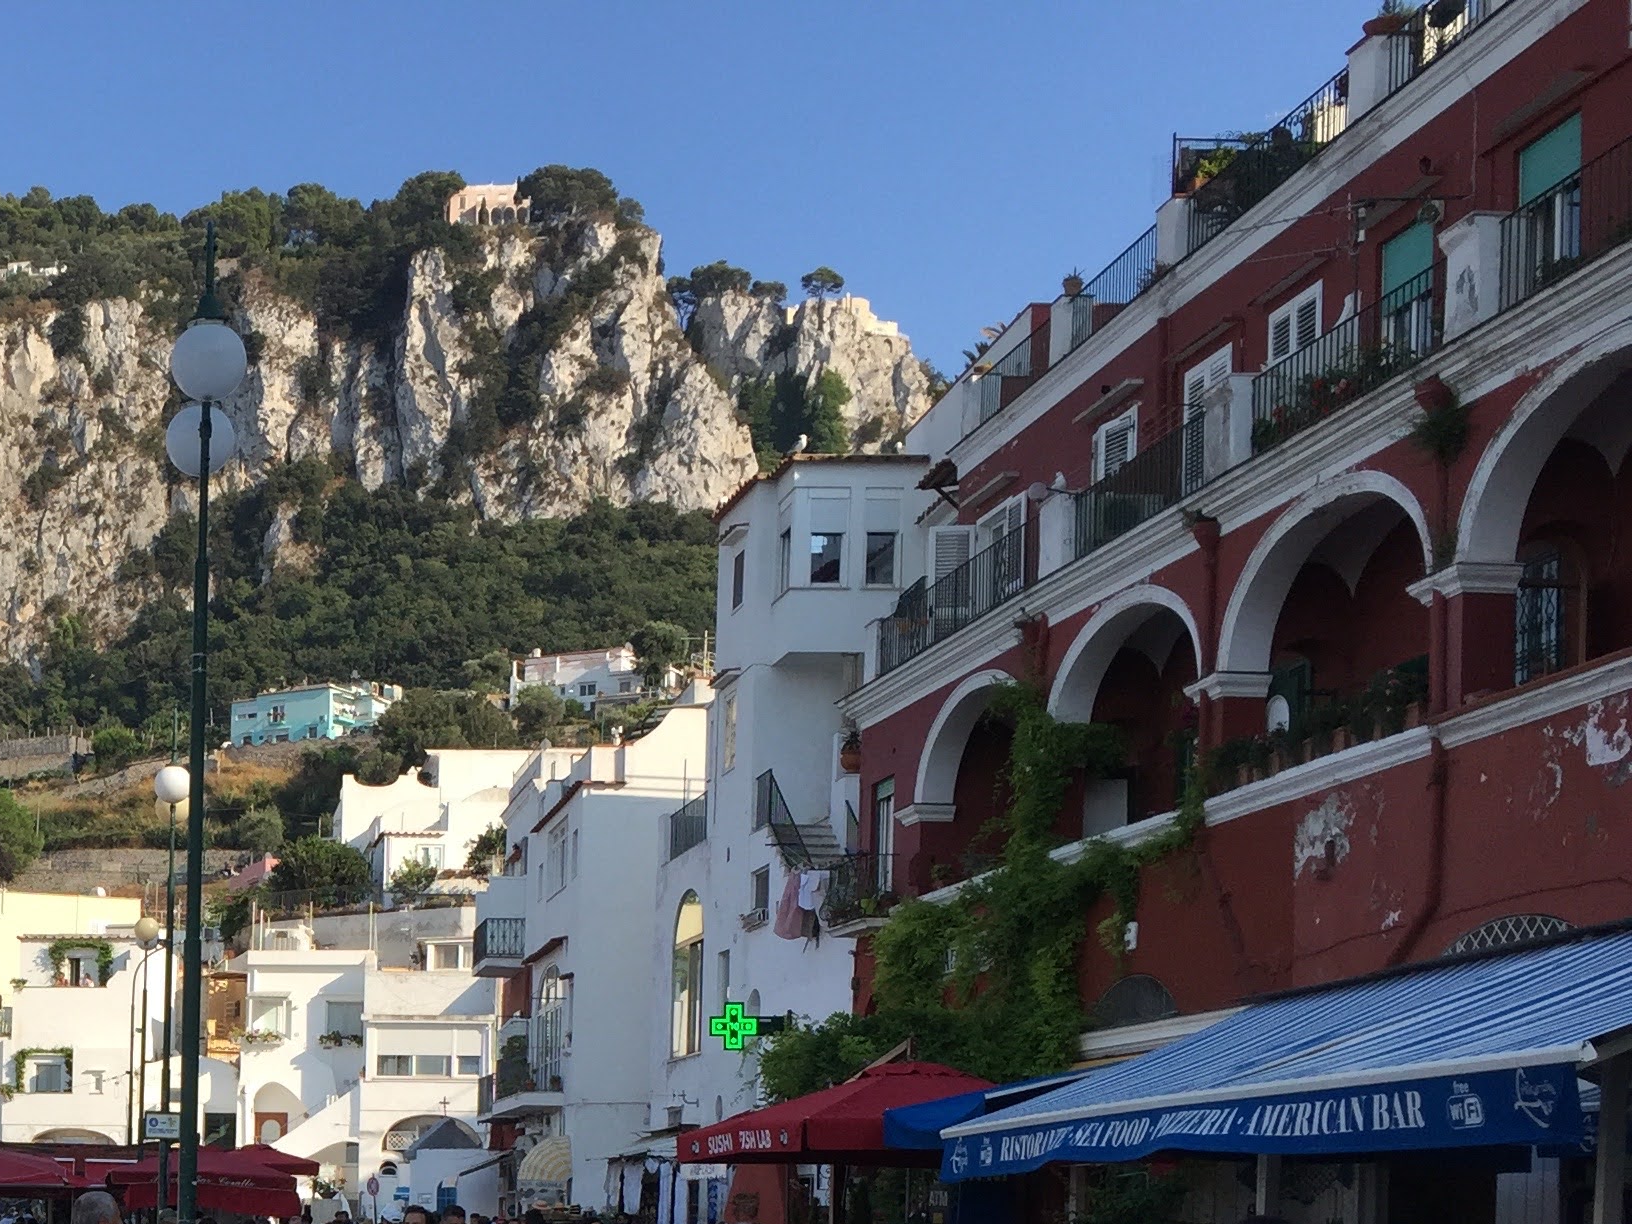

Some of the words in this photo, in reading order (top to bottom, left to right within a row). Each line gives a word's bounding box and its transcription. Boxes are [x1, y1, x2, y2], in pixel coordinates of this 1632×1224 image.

[1099, 1116, 1150, 1148] FOOD
[1150, 1107, 1239, 1142] PIZZERIA
[1240, 1095, 1366, 1137] AMERICAN
[1372, 1090, 1426, 1132] BAR
[708, 1132, 734, 1155] SUSHI
[756, 1129, 772, 1149] LAB
[928, 1190, 948, 1207] ATM
